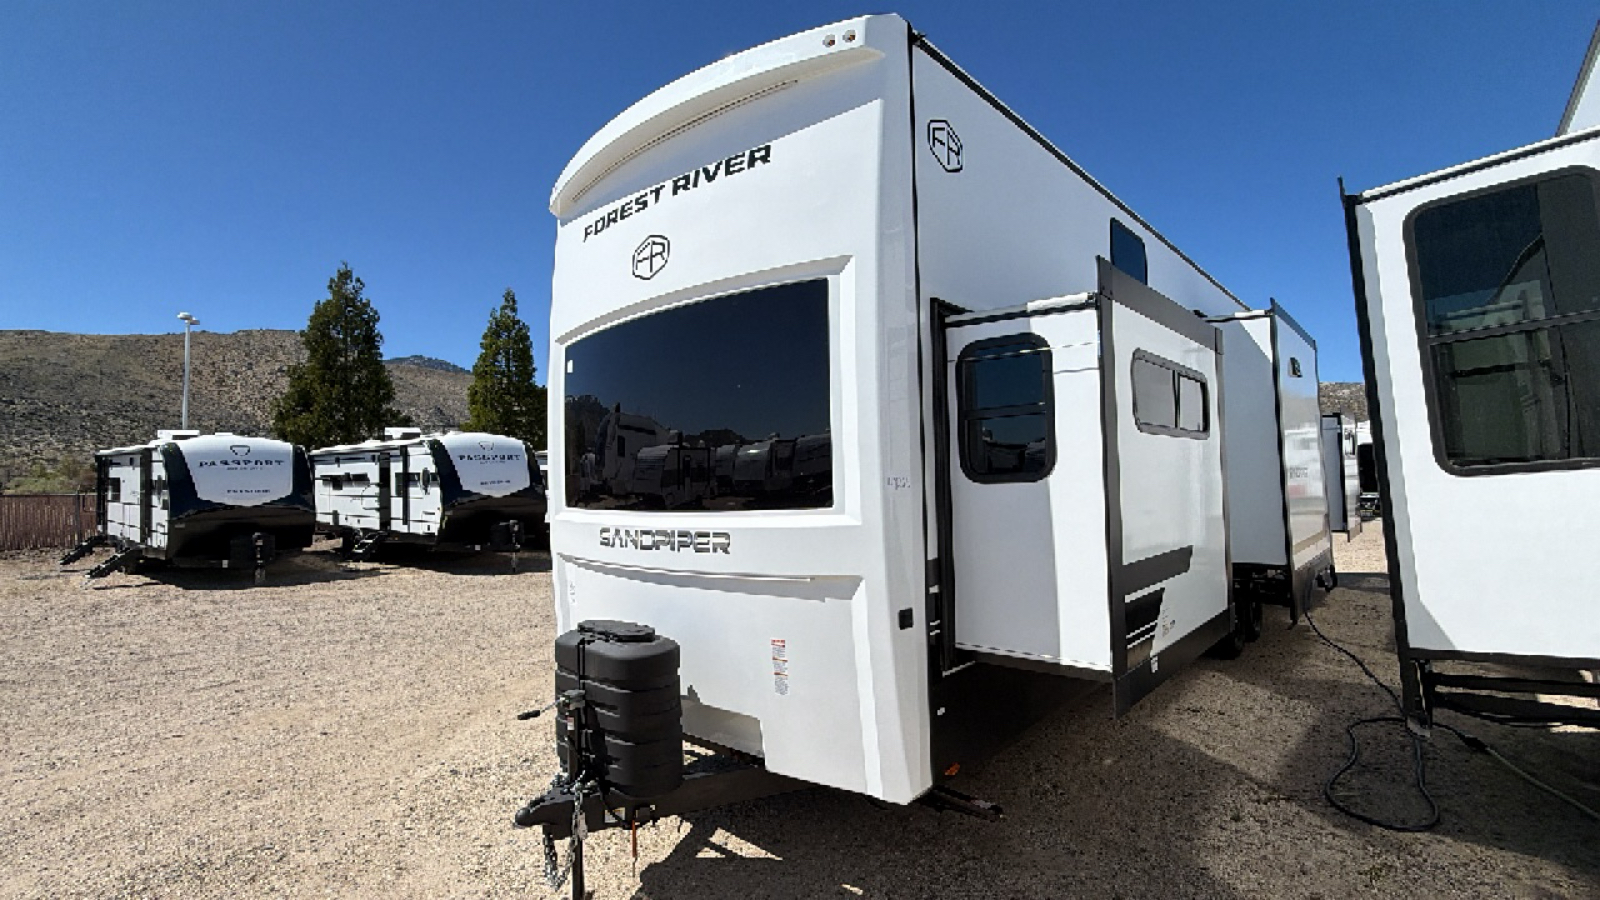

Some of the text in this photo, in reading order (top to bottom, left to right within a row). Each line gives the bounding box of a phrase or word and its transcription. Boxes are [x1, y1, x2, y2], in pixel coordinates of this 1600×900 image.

[583, 144, 772, 243] FOREST RIVER
[599, 526, 731, 555] SANDPIPER
